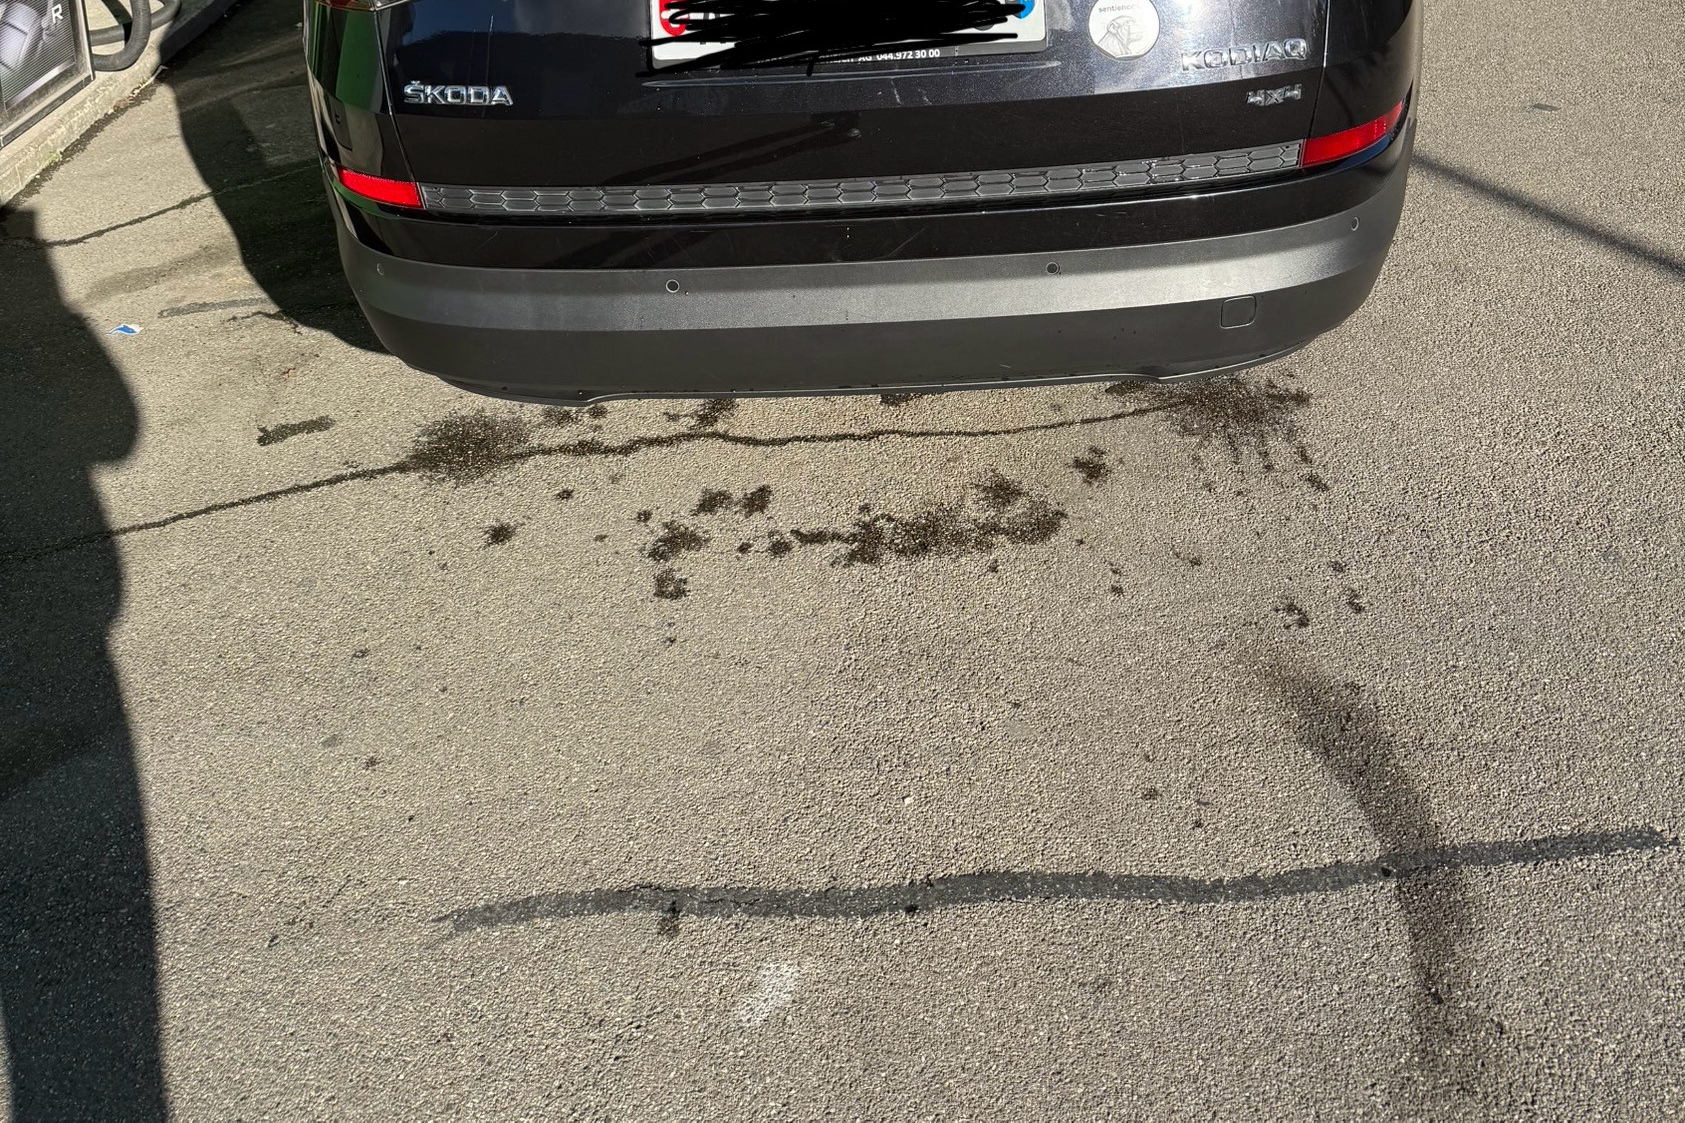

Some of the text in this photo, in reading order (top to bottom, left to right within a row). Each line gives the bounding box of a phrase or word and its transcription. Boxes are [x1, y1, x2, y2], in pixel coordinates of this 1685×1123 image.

[876, 51, 913, 61] 044.972
[915, 49, 927, 59] 30
[928, 48, 941, 58] 00
[1180, 37, 1309, 72] KODIAQ
[403, 80, 514, 106] ŠKODA
